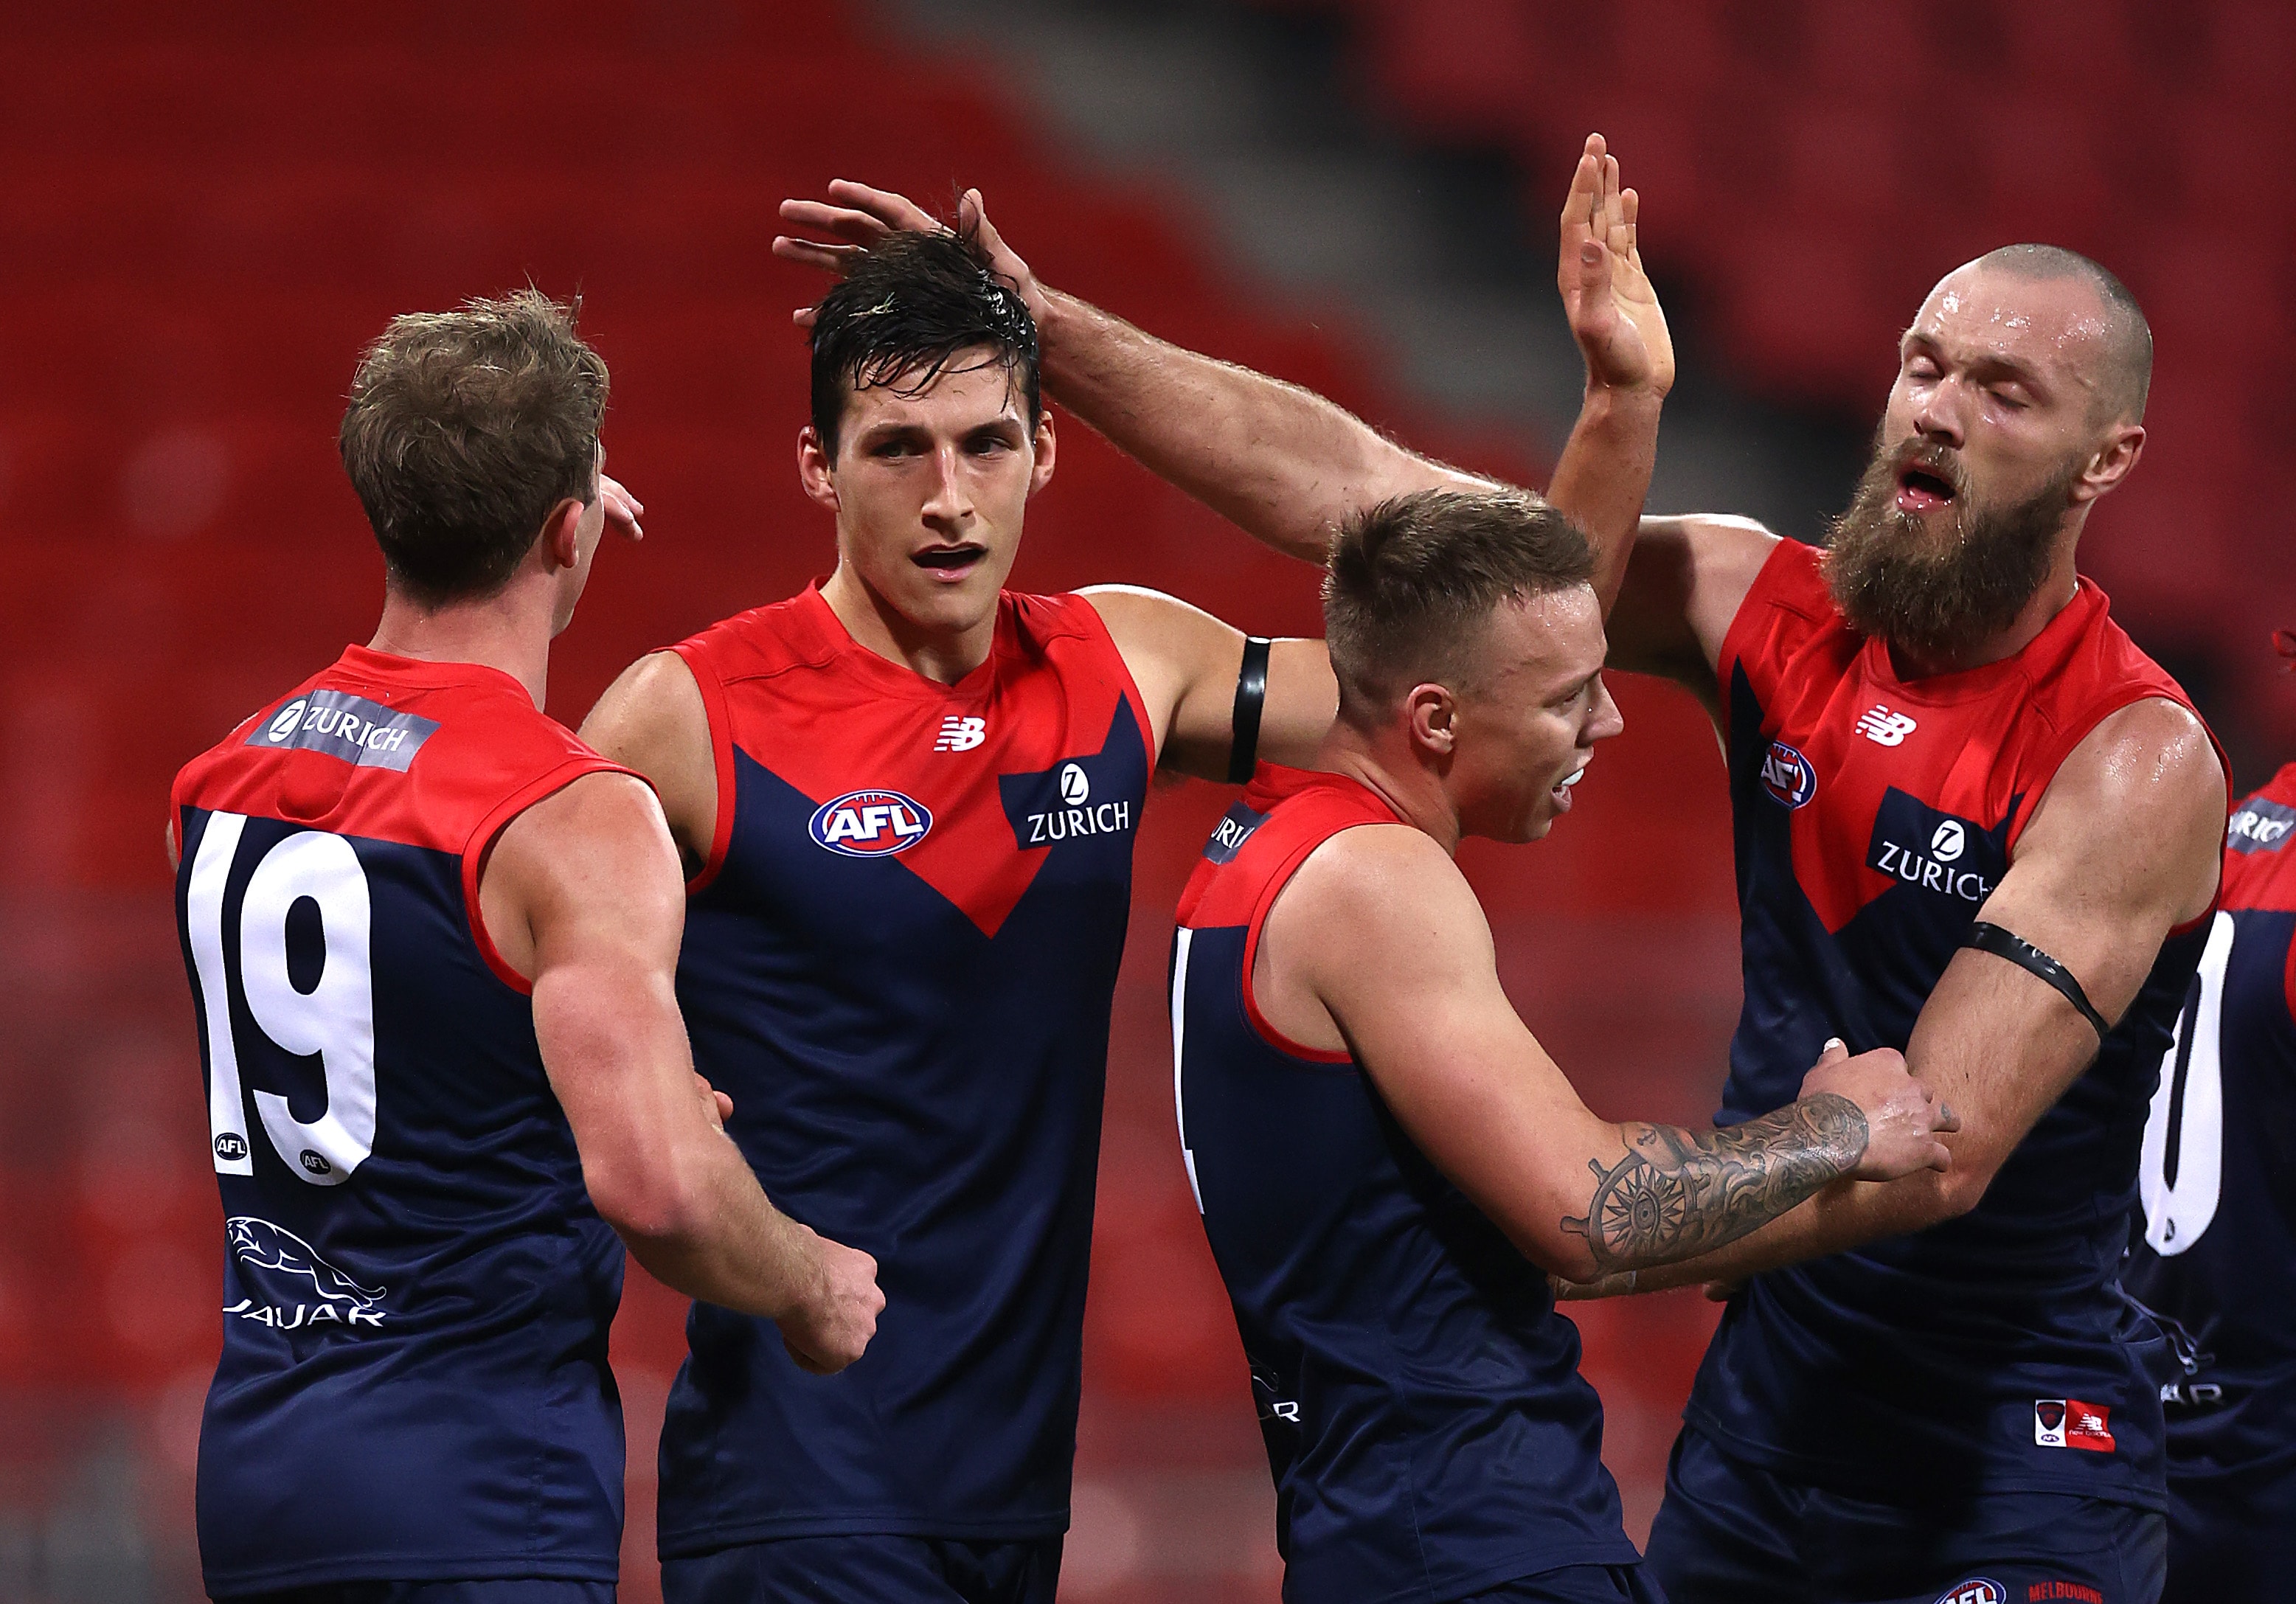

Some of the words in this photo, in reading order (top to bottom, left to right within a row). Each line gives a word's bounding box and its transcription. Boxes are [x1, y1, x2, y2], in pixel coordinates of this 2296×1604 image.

[302, 706, 409, 751] ZURICH
[824, 805, 924, 843] AFL
[1027, 802, 1130, 842] ZURICH
[187, 810, 377, 1187] 19
[217, 1139, 246, 1154] AFL
[304, 1155, 329, 1170] AFL
[2028, 1580, 2103, 1604] MELBOURNE
